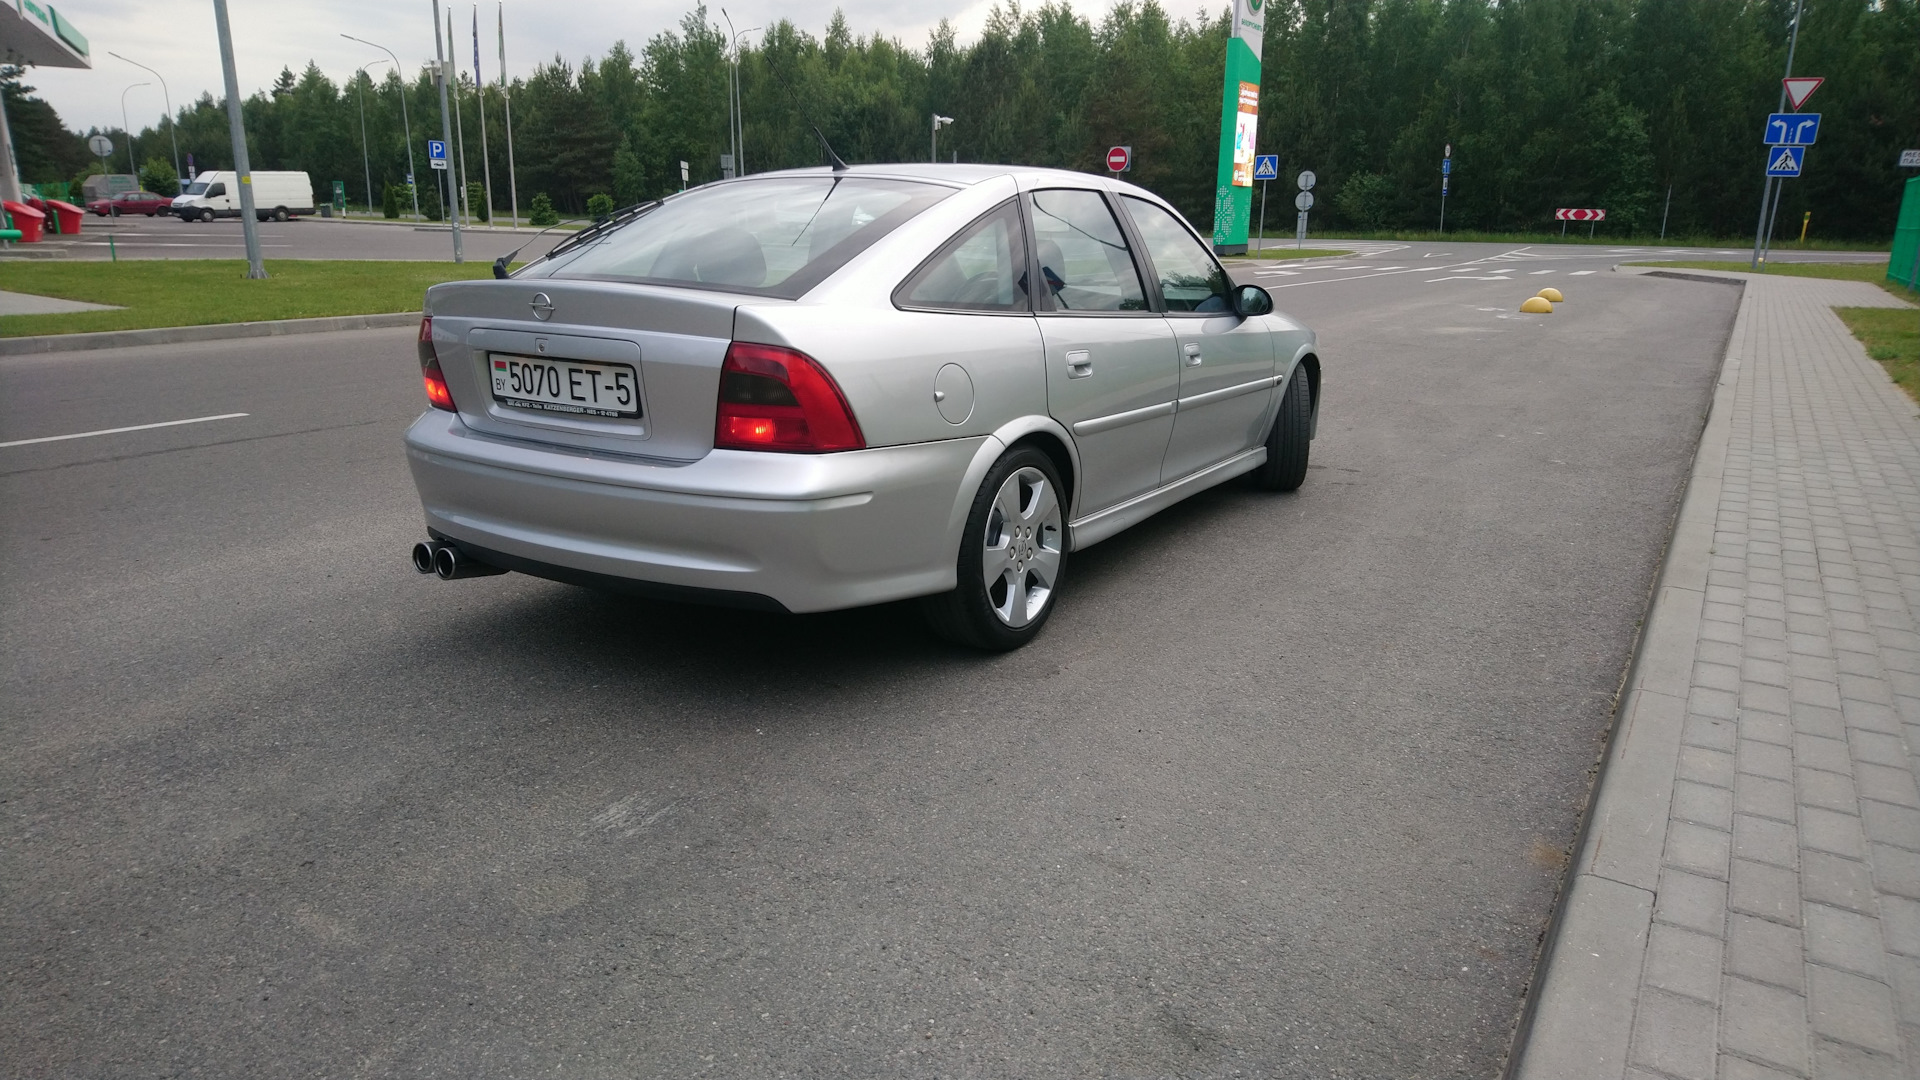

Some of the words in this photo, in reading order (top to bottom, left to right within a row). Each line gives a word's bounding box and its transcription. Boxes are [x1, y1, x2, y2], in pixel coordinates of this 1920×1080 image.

[432, 142, 442, 157] P
[495, 378, 506, 391] BY
[509, 361, 561, 398] 5070
[568, 367, 631, 406] ET-5
